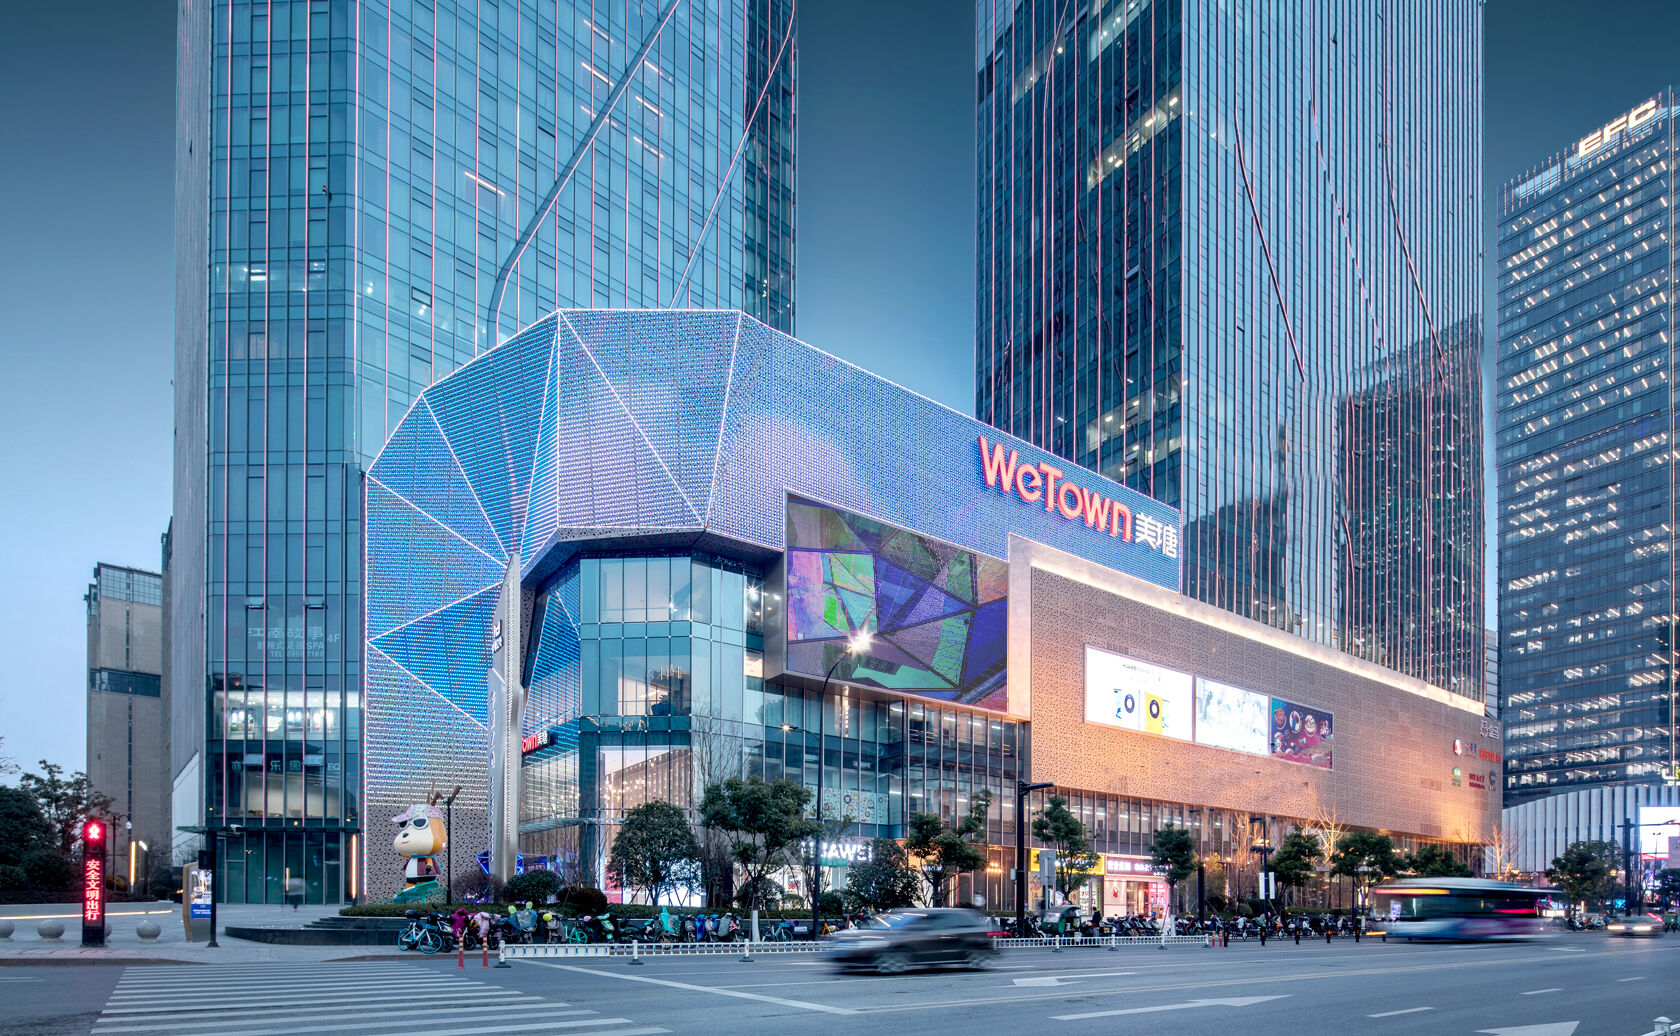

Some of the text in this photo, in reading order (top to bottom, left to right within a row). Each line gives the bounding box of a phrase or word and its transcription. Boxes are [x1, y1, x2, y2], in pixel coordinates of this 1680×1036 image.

[1578, 99, 1656, 158] EFC
[977, 436, 1132, 542] WeTown
[85, 860, 100, 920] 安全文明出行
